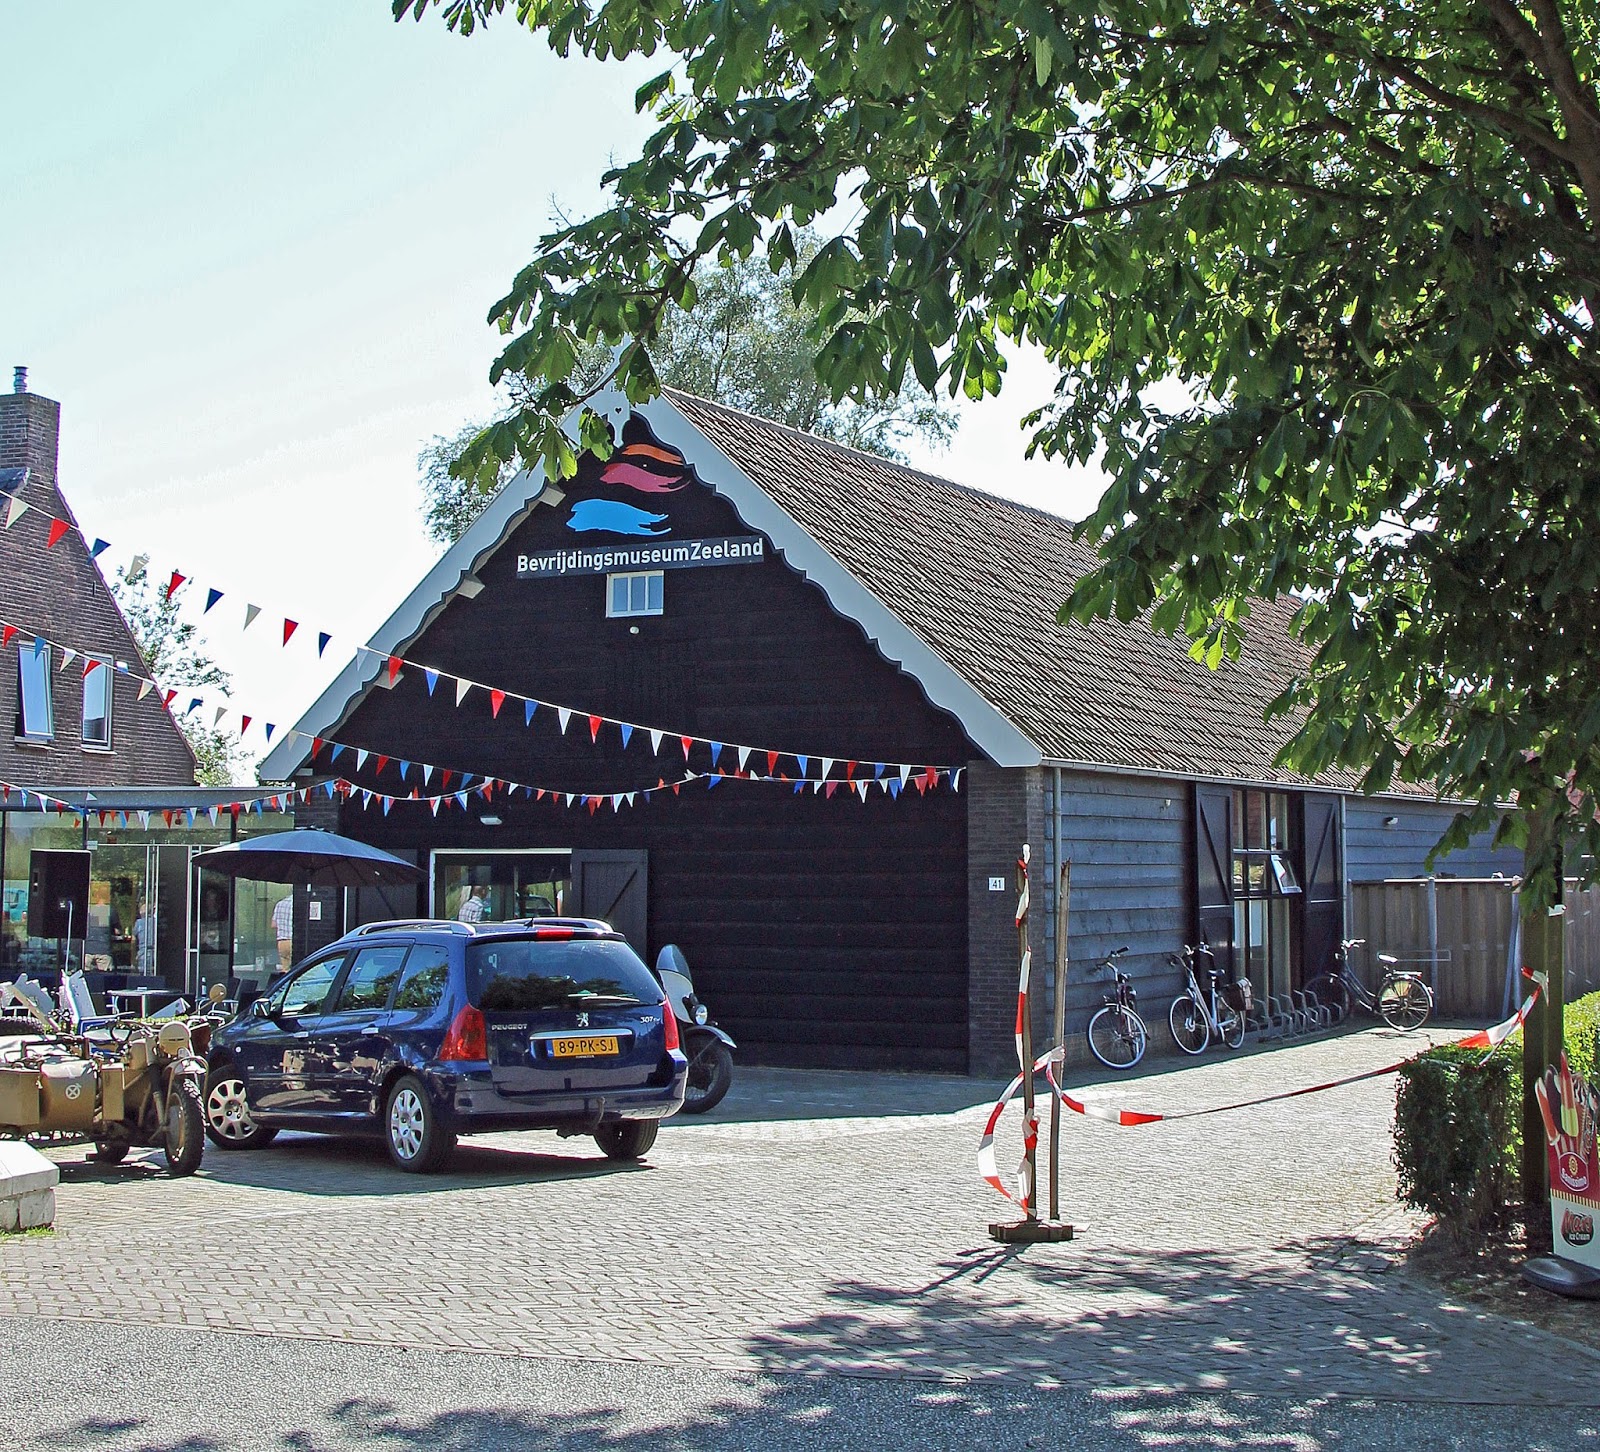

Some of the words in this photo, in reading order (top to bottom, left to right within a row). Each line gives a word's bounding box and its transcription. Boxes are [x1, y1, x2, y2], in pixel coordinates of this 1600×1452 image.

[992, 879, 1001, 889] 41
[491, 1023, 528, 1031] PEUGEOT
[558, 1038, 615, 1054] 89-PK-SJ
